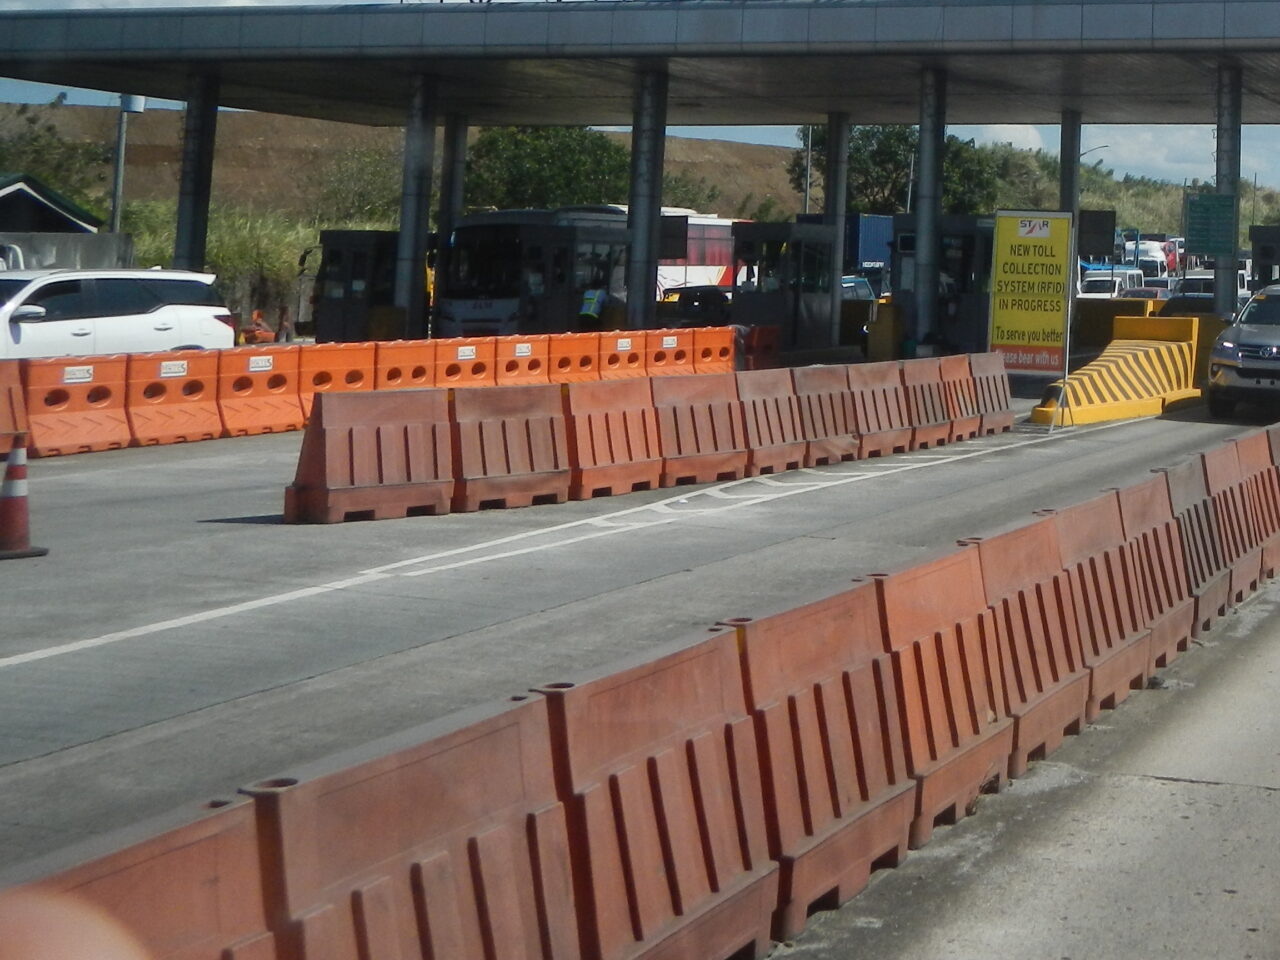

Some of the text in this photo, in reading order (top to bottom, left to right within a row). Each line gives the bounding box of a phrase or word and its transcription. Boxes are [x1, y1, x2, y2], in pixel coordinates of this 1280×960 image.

[1020, 219, 1049, 231] STAR
[1010, 244, 1056, 258] NEW TOLL
[1002, 262, 1062, 276] COLLECTION
[997, 280, 1065, 295] SYSTEM (RFID)
[999, 298, 1061, 312] IN PROGRESS
[996, 326, 1063, 344] To serve you better
[1018, 350, 1034, 365] bear
